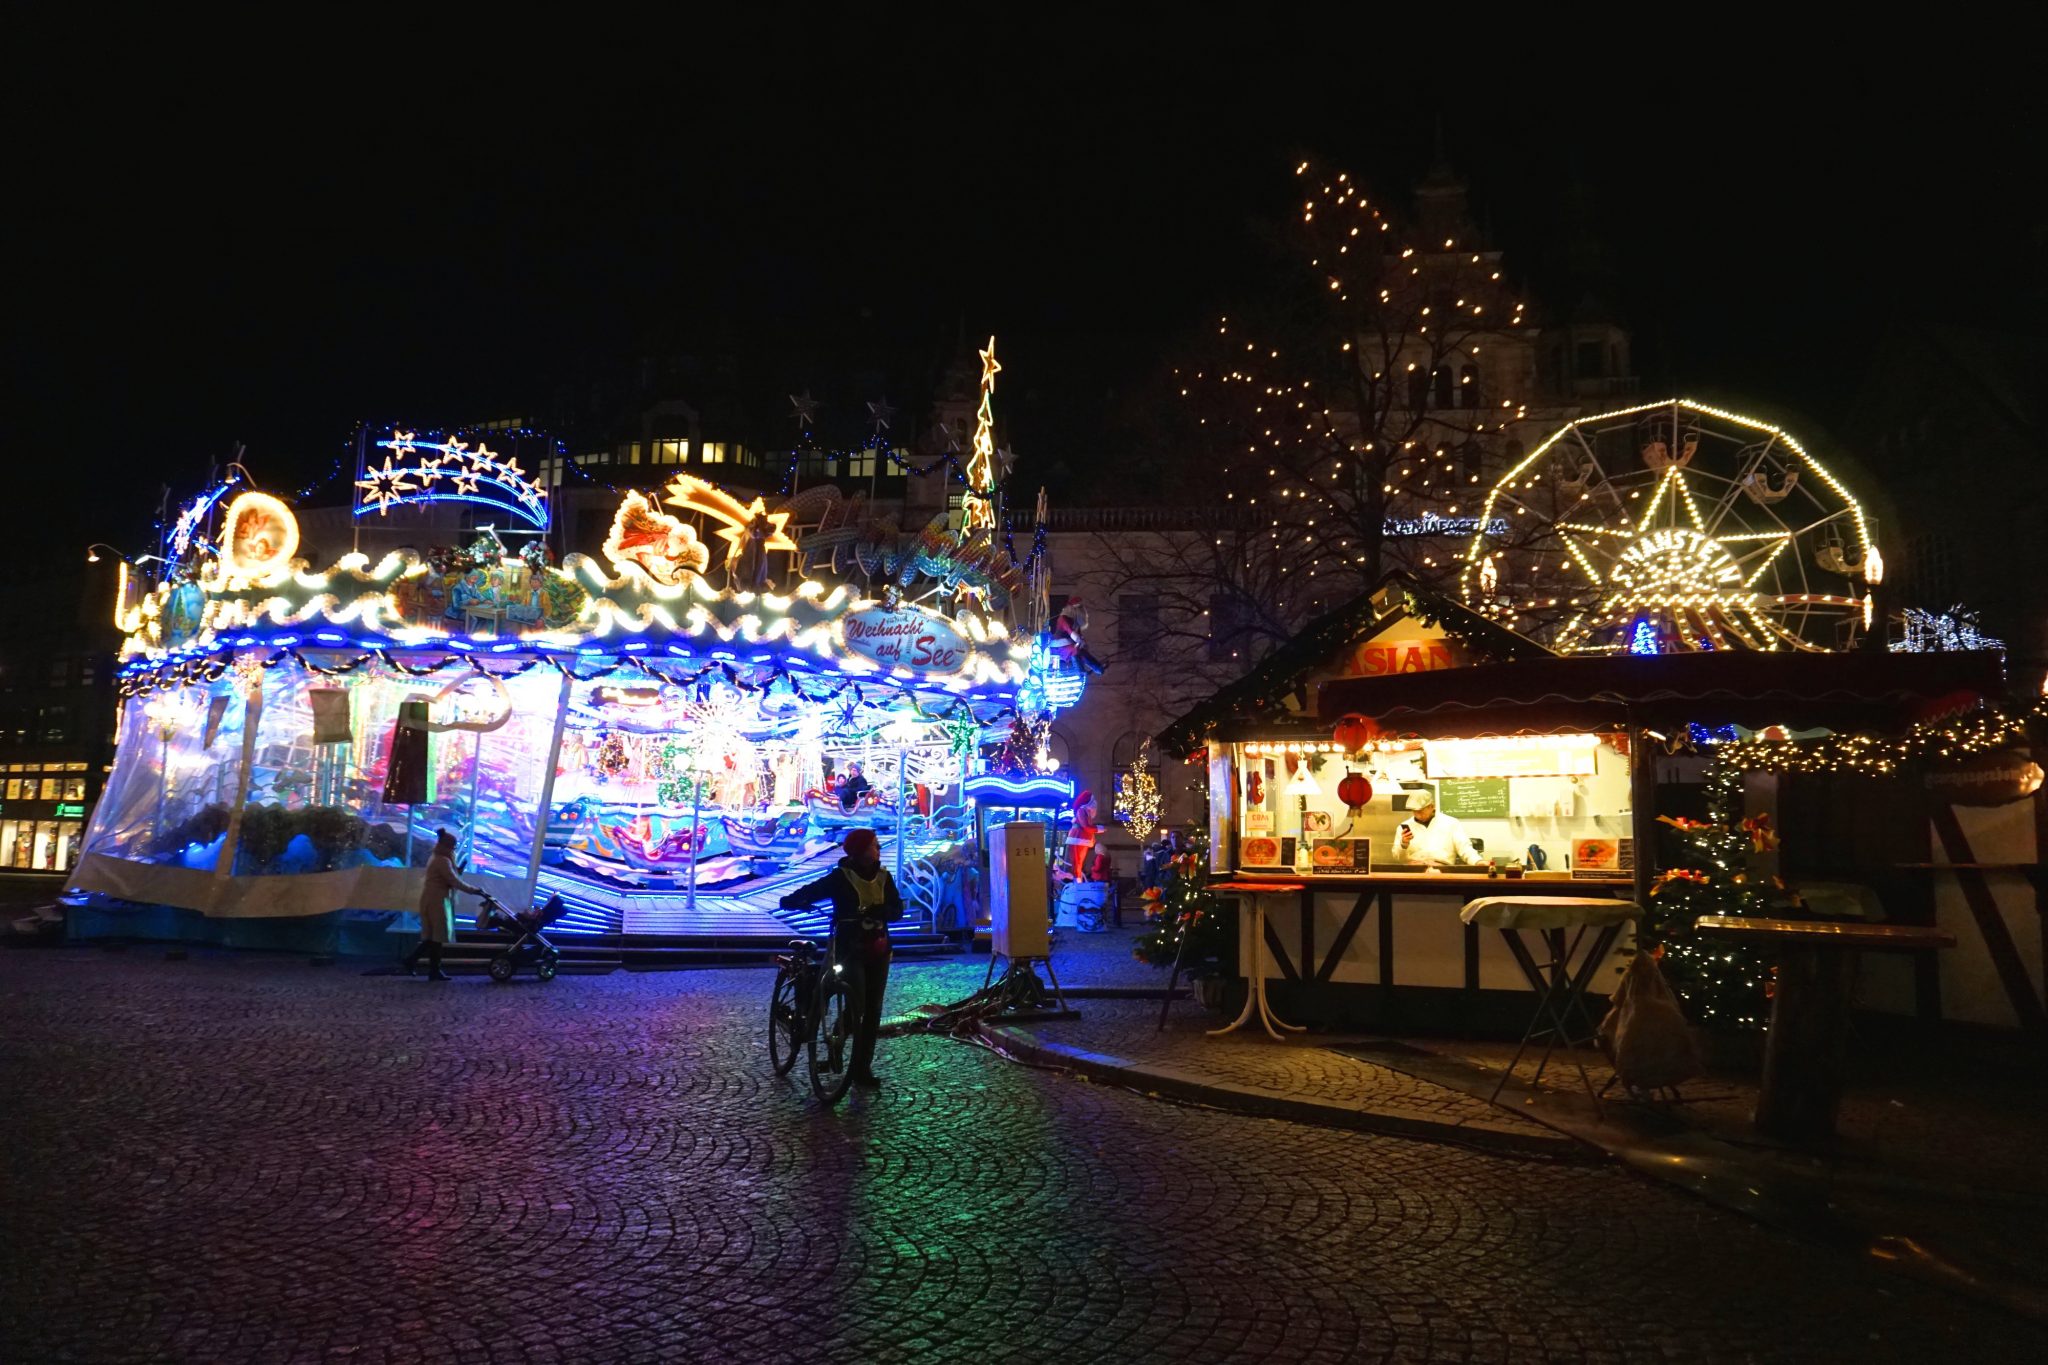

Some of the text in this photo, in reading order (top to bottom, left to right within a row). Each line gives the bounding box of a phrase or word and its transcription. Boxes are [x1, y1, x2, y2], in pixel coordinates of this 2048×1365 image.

[847, 616, 925, 638] Weihnacht
[876, 635, 955, 666] auf See
[1348, 645, 1454, 676] ASIAN
[1015, 847, 1037, 857] 251
